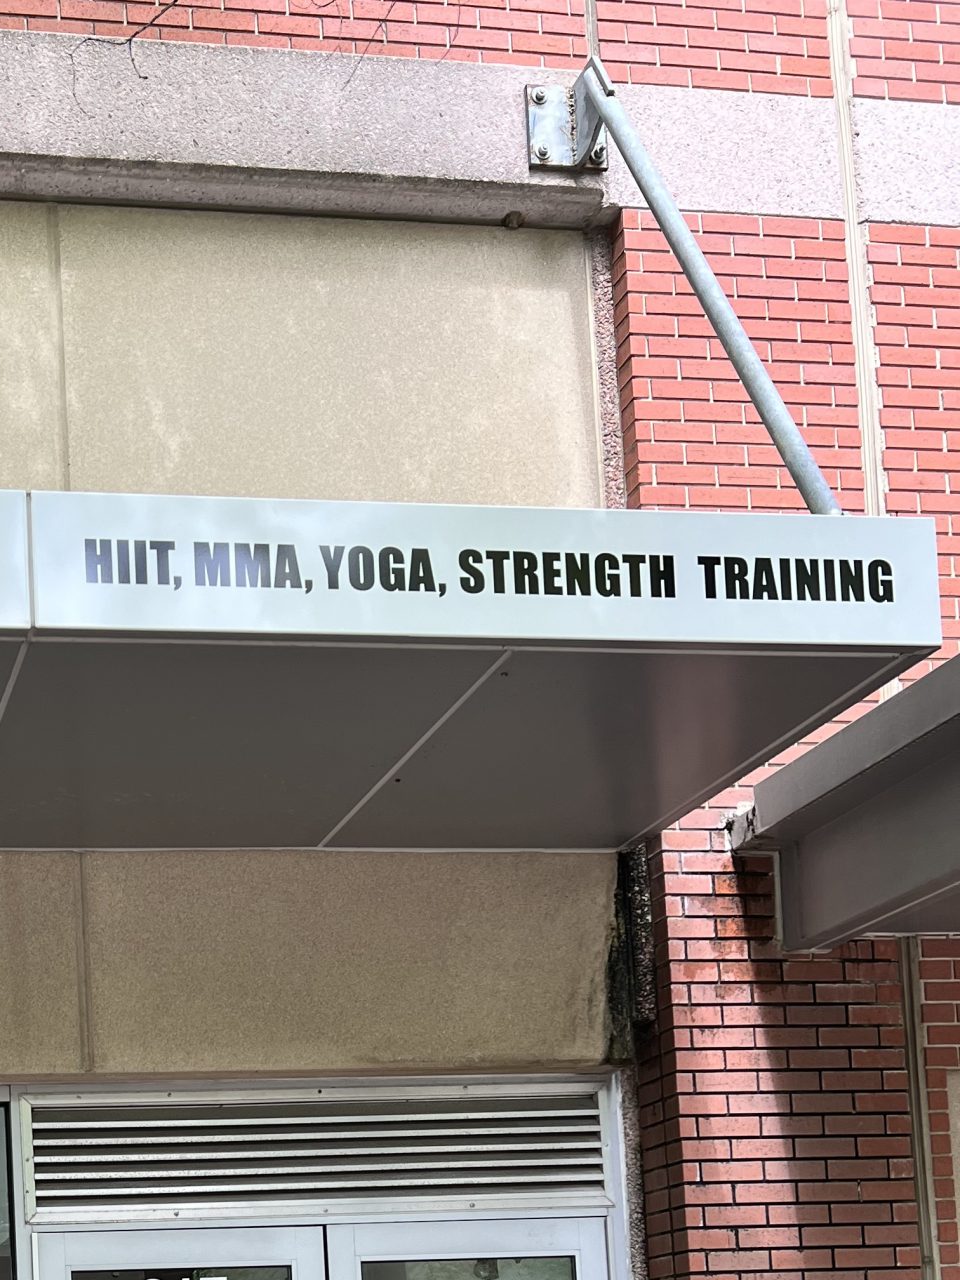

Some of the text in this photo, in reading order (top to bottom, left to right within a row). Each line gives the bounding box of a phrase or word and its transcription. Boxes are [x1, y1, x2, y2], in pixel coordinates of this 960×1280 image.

[84, 538, 895, 603] HIIT, MMA, YOGA, STRENGTH TRAINING
